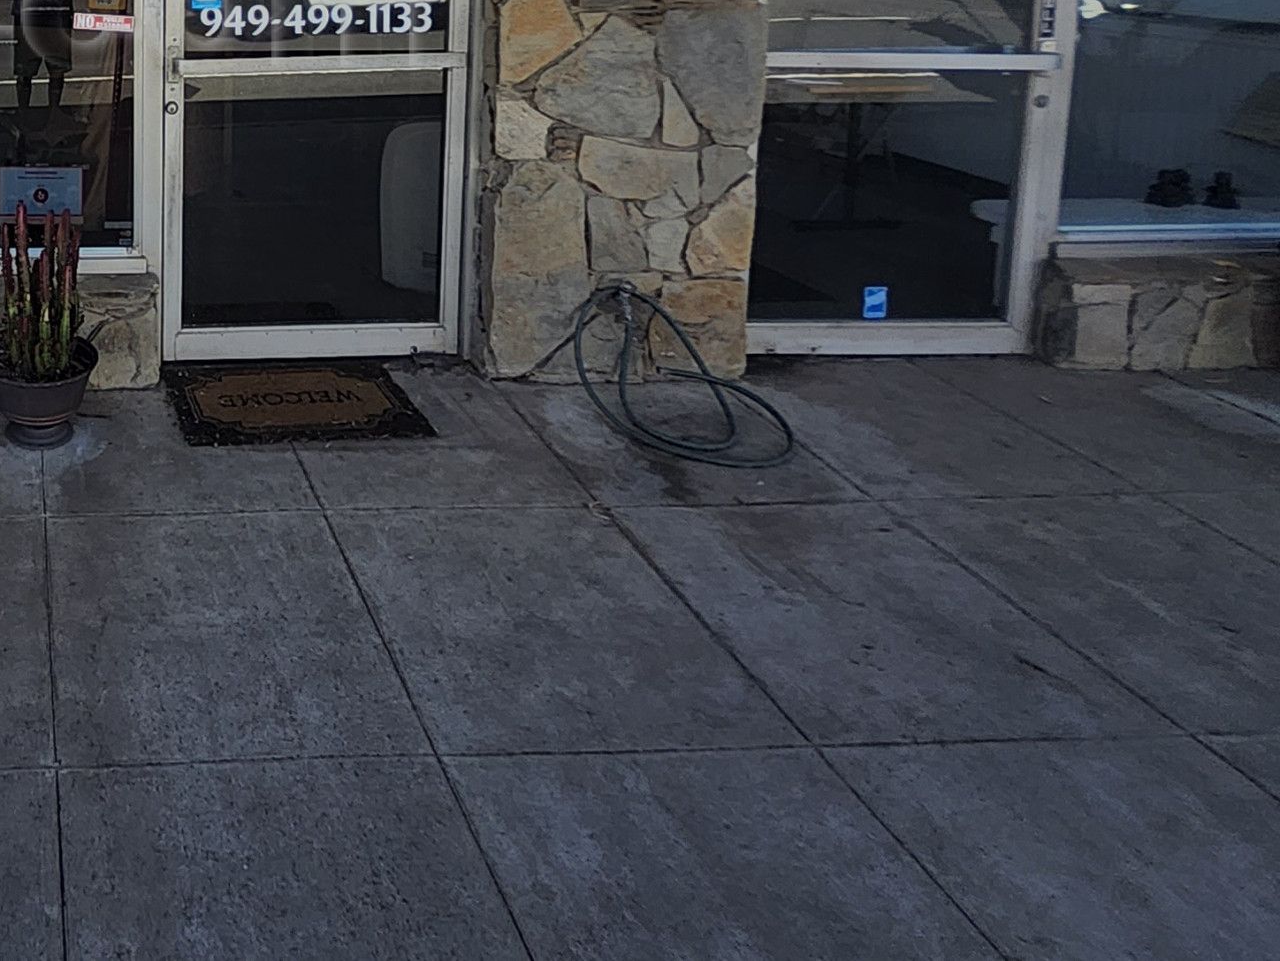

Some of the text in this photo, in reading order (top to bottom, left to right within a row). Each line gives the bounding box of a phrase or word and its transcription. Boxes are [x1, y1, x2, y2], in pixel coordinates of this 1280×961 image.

[74, 13, 95, 29] NO
[200, 2, 433, 37] 949-499-1133
[220, 389, 364, 408] WELCOME
